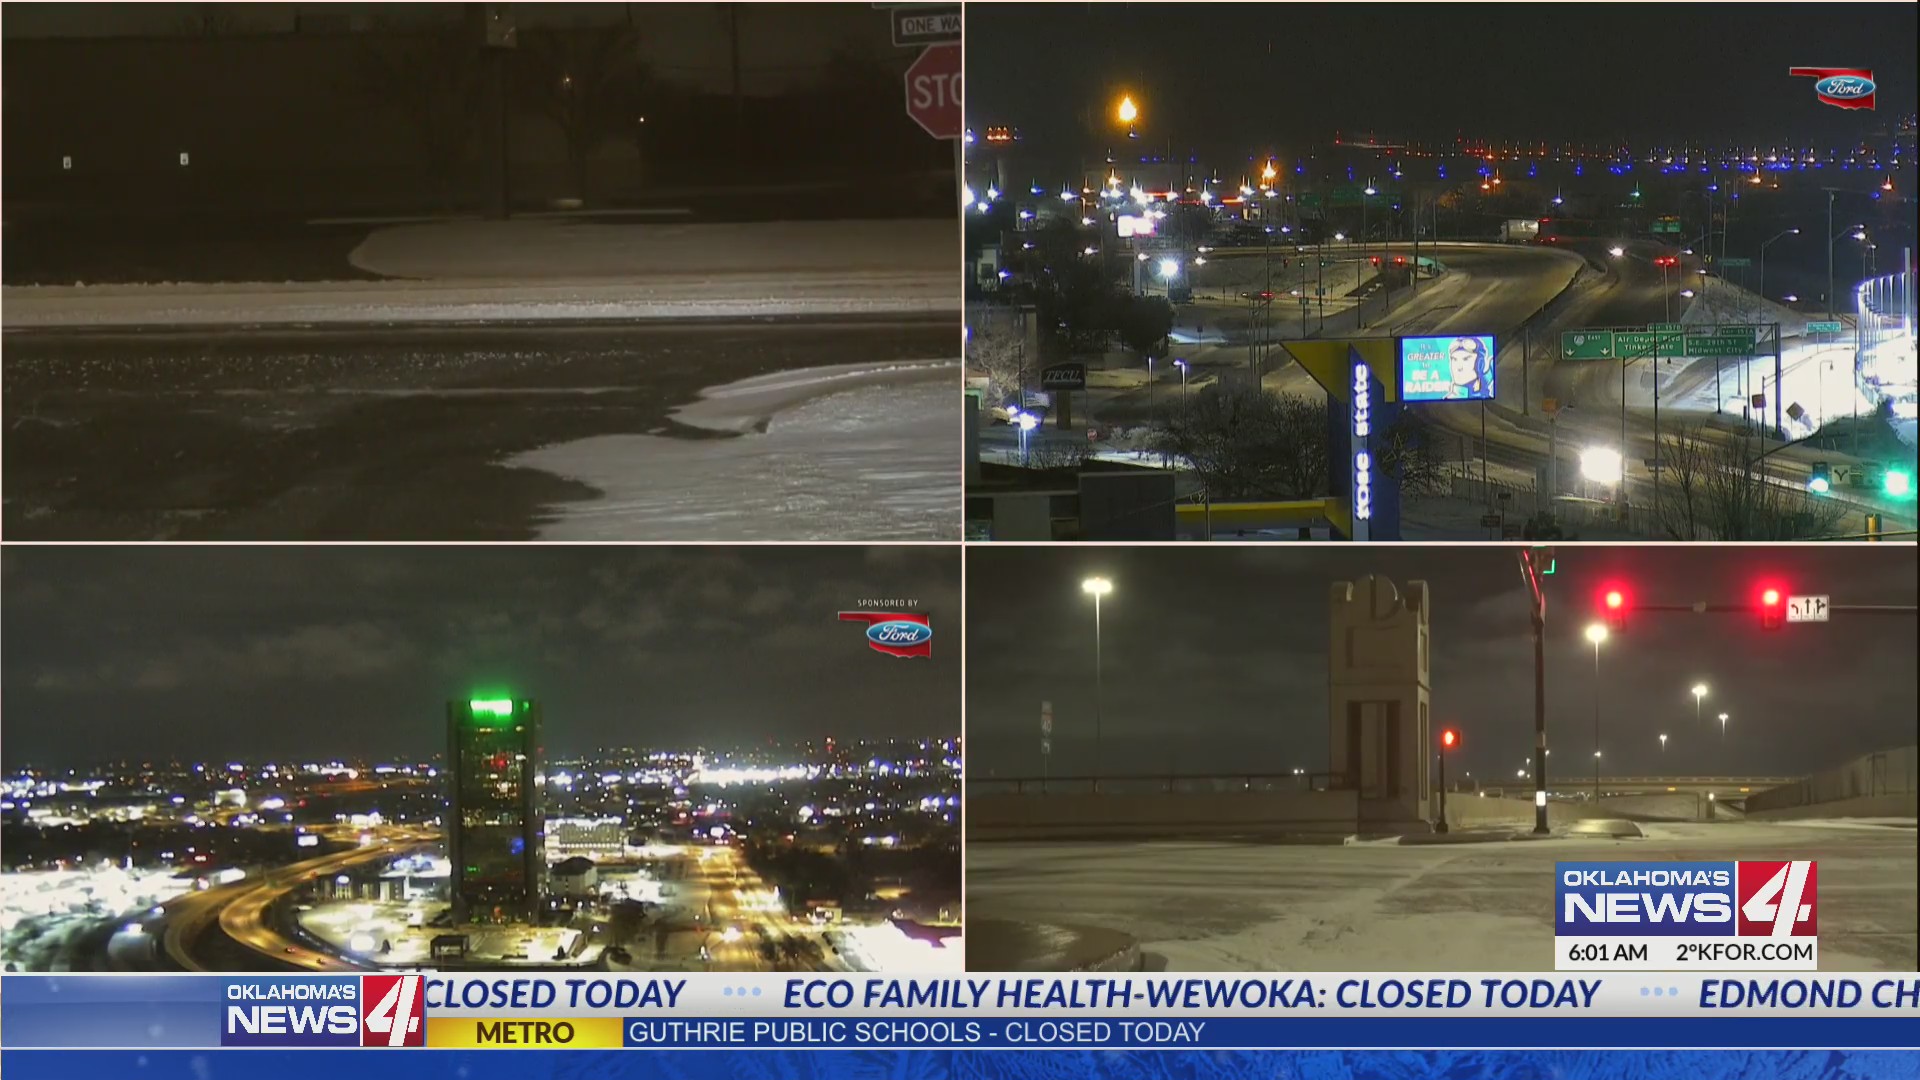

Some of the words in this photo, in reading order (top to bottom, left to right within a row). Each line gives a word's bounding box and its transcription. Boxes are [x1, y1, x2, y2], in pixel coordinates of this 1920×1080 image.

[905, 19, 936, 33] ONE
[940, 15, 961, 32] WA
[913, 73, 961, 109] STO
[1634, 335, 1659, 343] Depot
[1726, 347, 1743, 355] City
[1407, 352, 1445, 361] GREATER
[1412, 370, 1428, 381] BE
[1430, 370, 1440, 381] A
